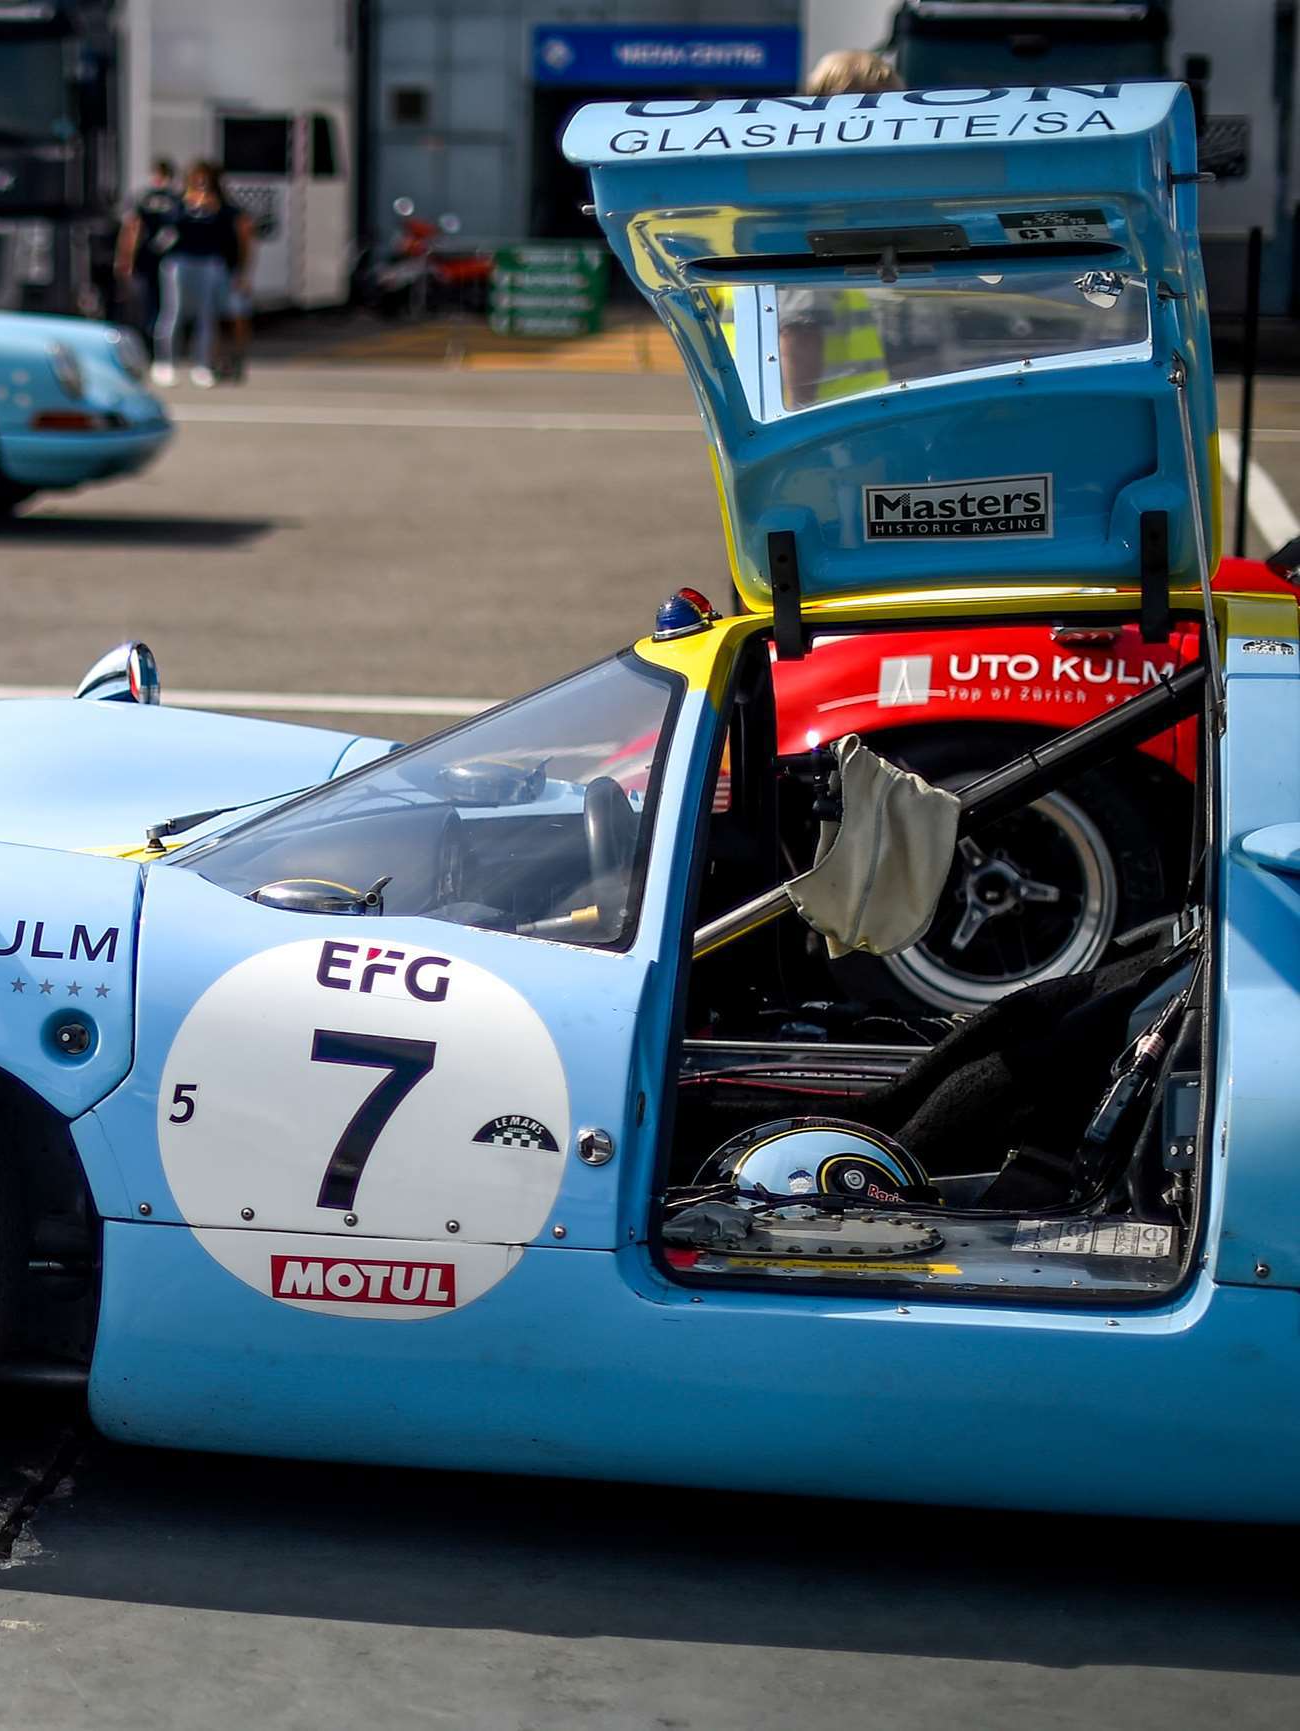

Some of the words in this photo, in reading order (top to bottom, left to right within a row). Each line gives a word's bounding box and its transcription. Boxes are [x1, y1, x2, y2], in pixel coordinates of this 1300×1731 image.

[609, 110, 1116, 154] GLASHÜTTE/SA
[874, 492, 1042, 520] Masters
[875, 523, 961, 534] HISTORIC
[972, 518, 1041, 532] RACING
[950, 654, 1040, 681] UTO
[1052, 655, 1176, 685] KULM
[949, 686, 982, 703] Top
[991, 686, 1012, 700] of
[1019, 686, 1087, 704] Zürich
[316, 940, 452, 1002] EFG
[169, 1083, 197, 1125] 5
[310, 1028, 437, 1211] 7
[279, 1260, 449, 1302] MOTUL
